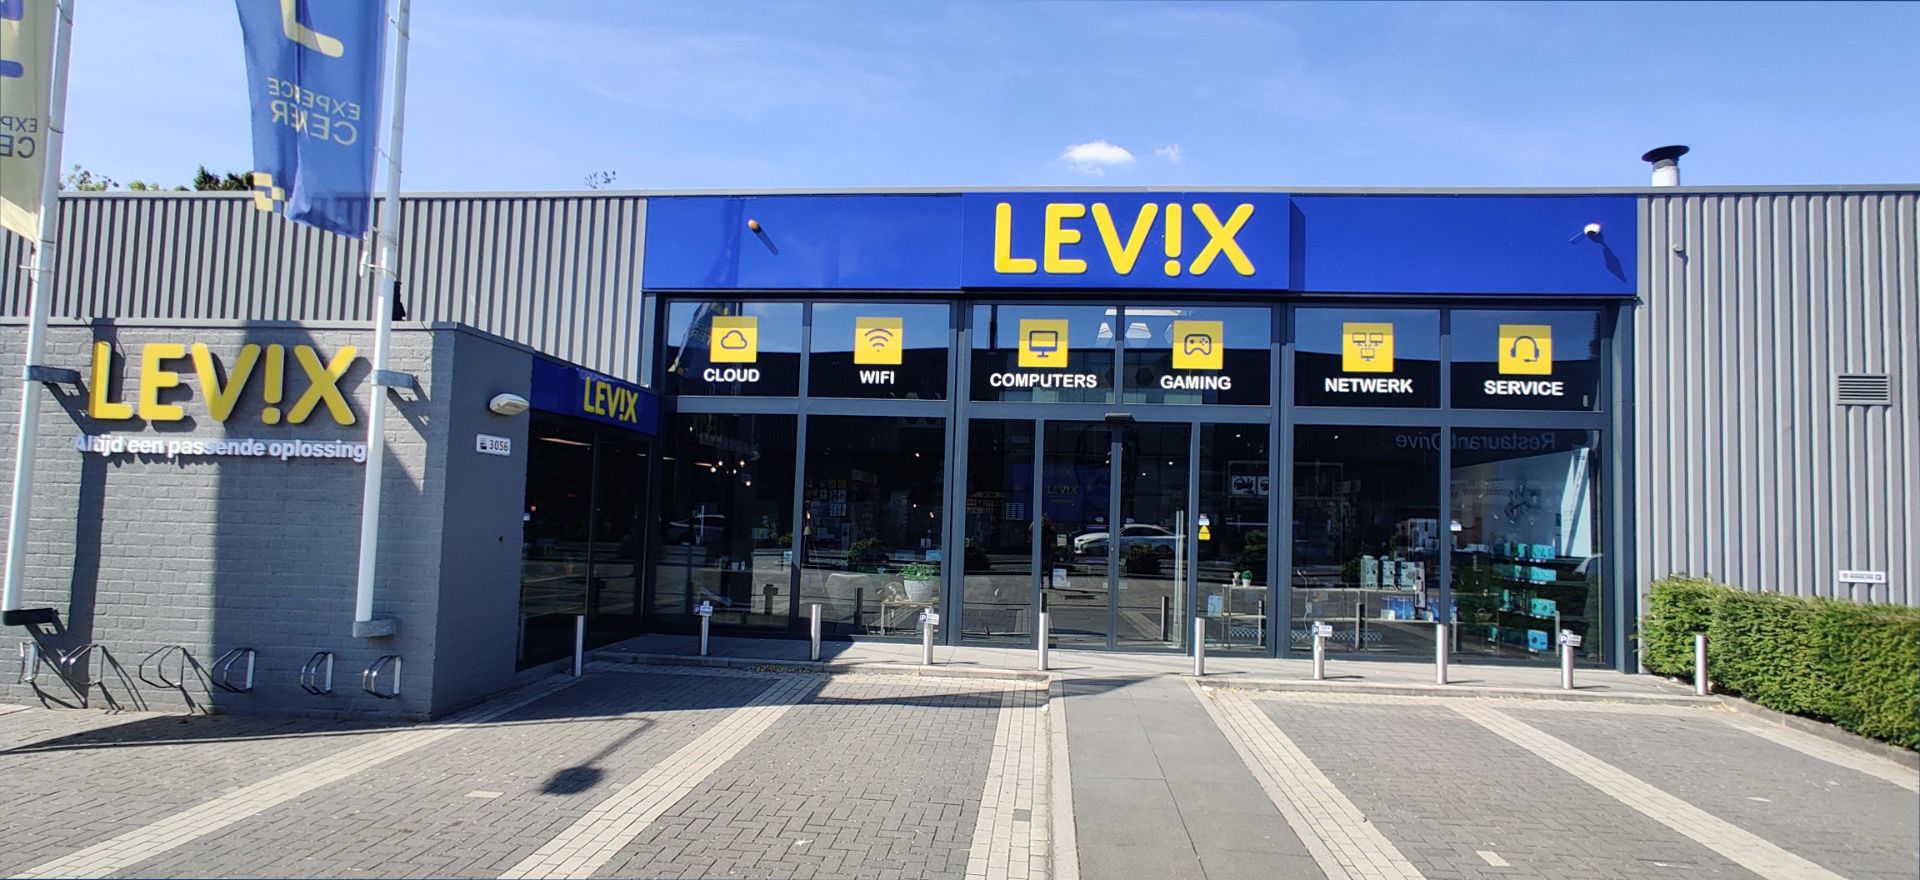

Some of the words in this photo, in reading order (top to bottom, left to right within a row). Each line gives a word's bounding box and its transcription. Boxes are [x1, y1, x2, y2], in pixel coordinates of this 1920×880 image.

[994, 202, 1256, 276] LEV!X
[88, 341, 357, 426] LEV!X
[703, 368, 760, 383] CLOUD
[859, 370, 895, 385] WIFI
[989, 373, 1098, 388] COMPUTERS
[1160, 375, 1232, 390] GAMING
[1324, 378, 1413, 394] NETWERK
[1484, 380, 1564, 396] SERVICE
[583, 376, 638, 424] LEV!X
[72, 434, 125, 457] Altijd
[127, 438, 165, 453] een
[167, 438, 266, 459] passende
[268, 439, 367, 463] oplossing
[489, 440, 509, 452] 3056
